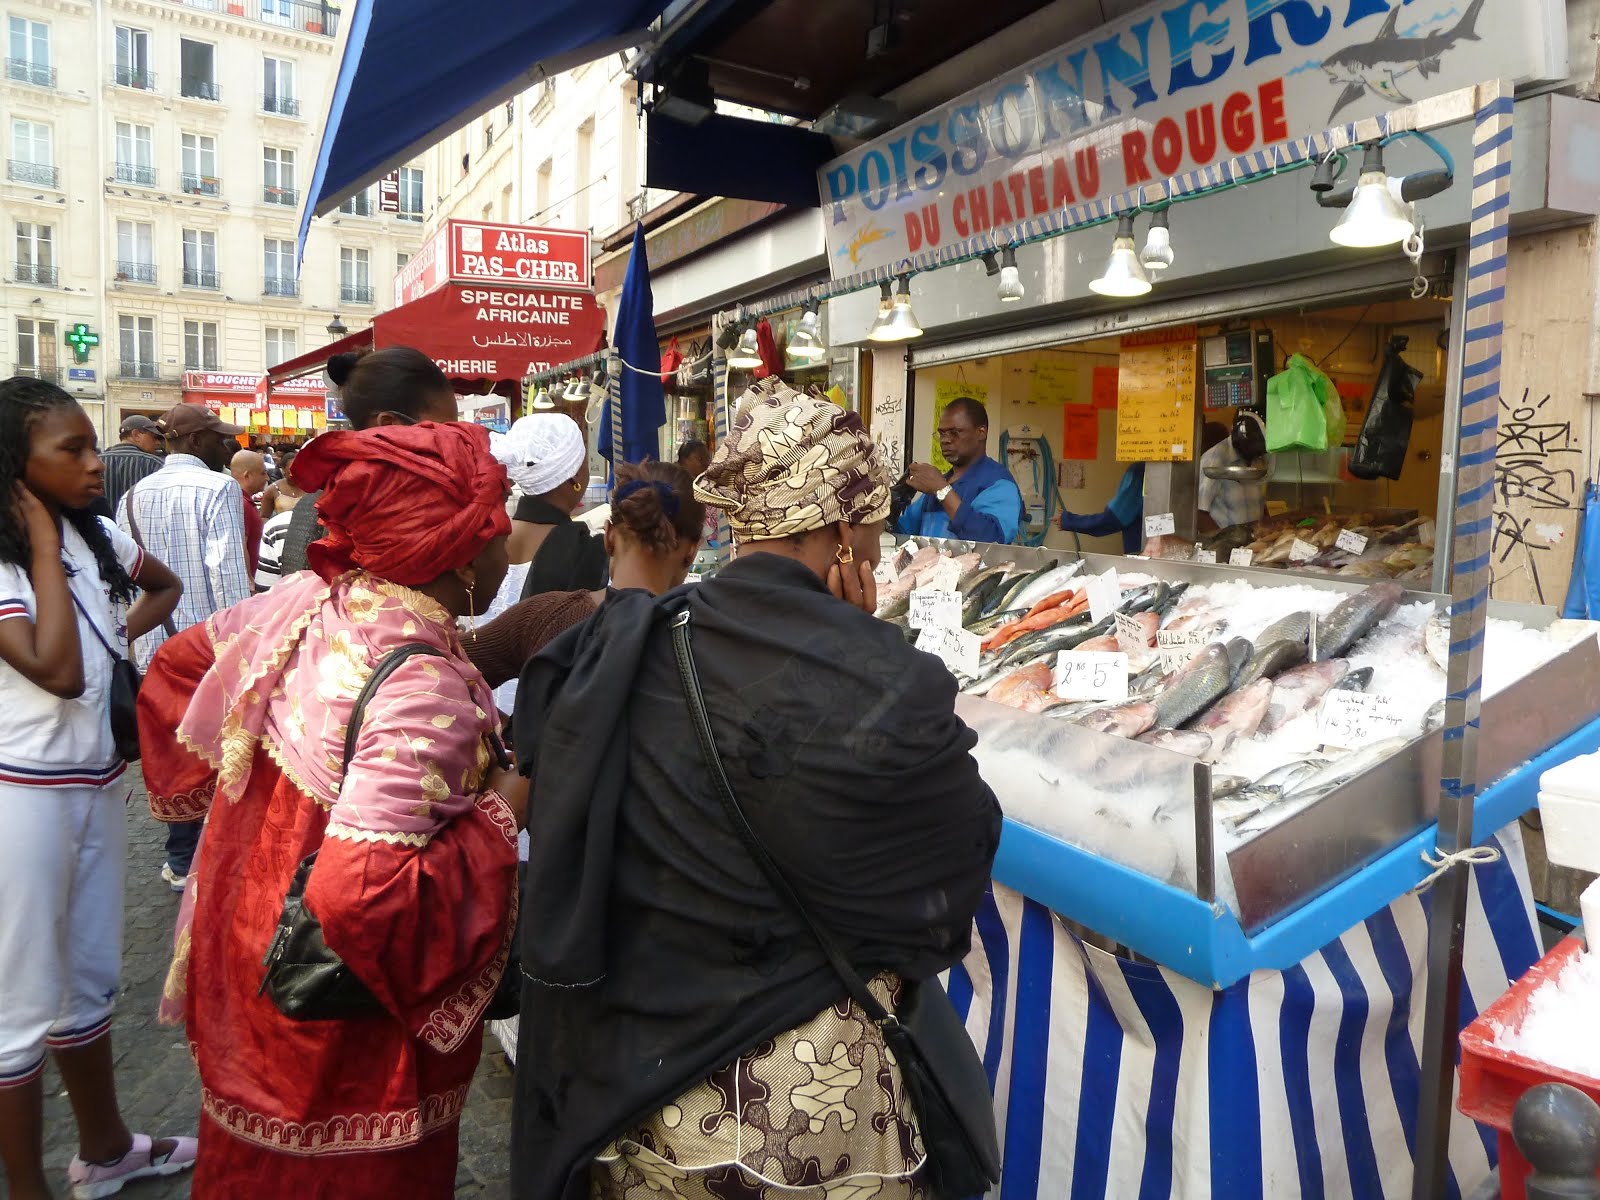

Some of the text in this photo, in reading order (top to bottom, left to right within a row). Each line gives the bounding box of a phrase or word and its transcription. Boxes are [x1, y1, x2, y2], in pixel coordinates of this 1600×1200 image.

[904, 77, 1288, 253] DU CHATEAU ROUGE
[495, 231, 549, 255] Atlas
[462, 254, 579, 282] PAS-CHER
[460, 289, 583, 310] SPECIALITE
[476, 308, 570, 325] AFRICAINE
[431, 359, 497, 374] CHERIE
